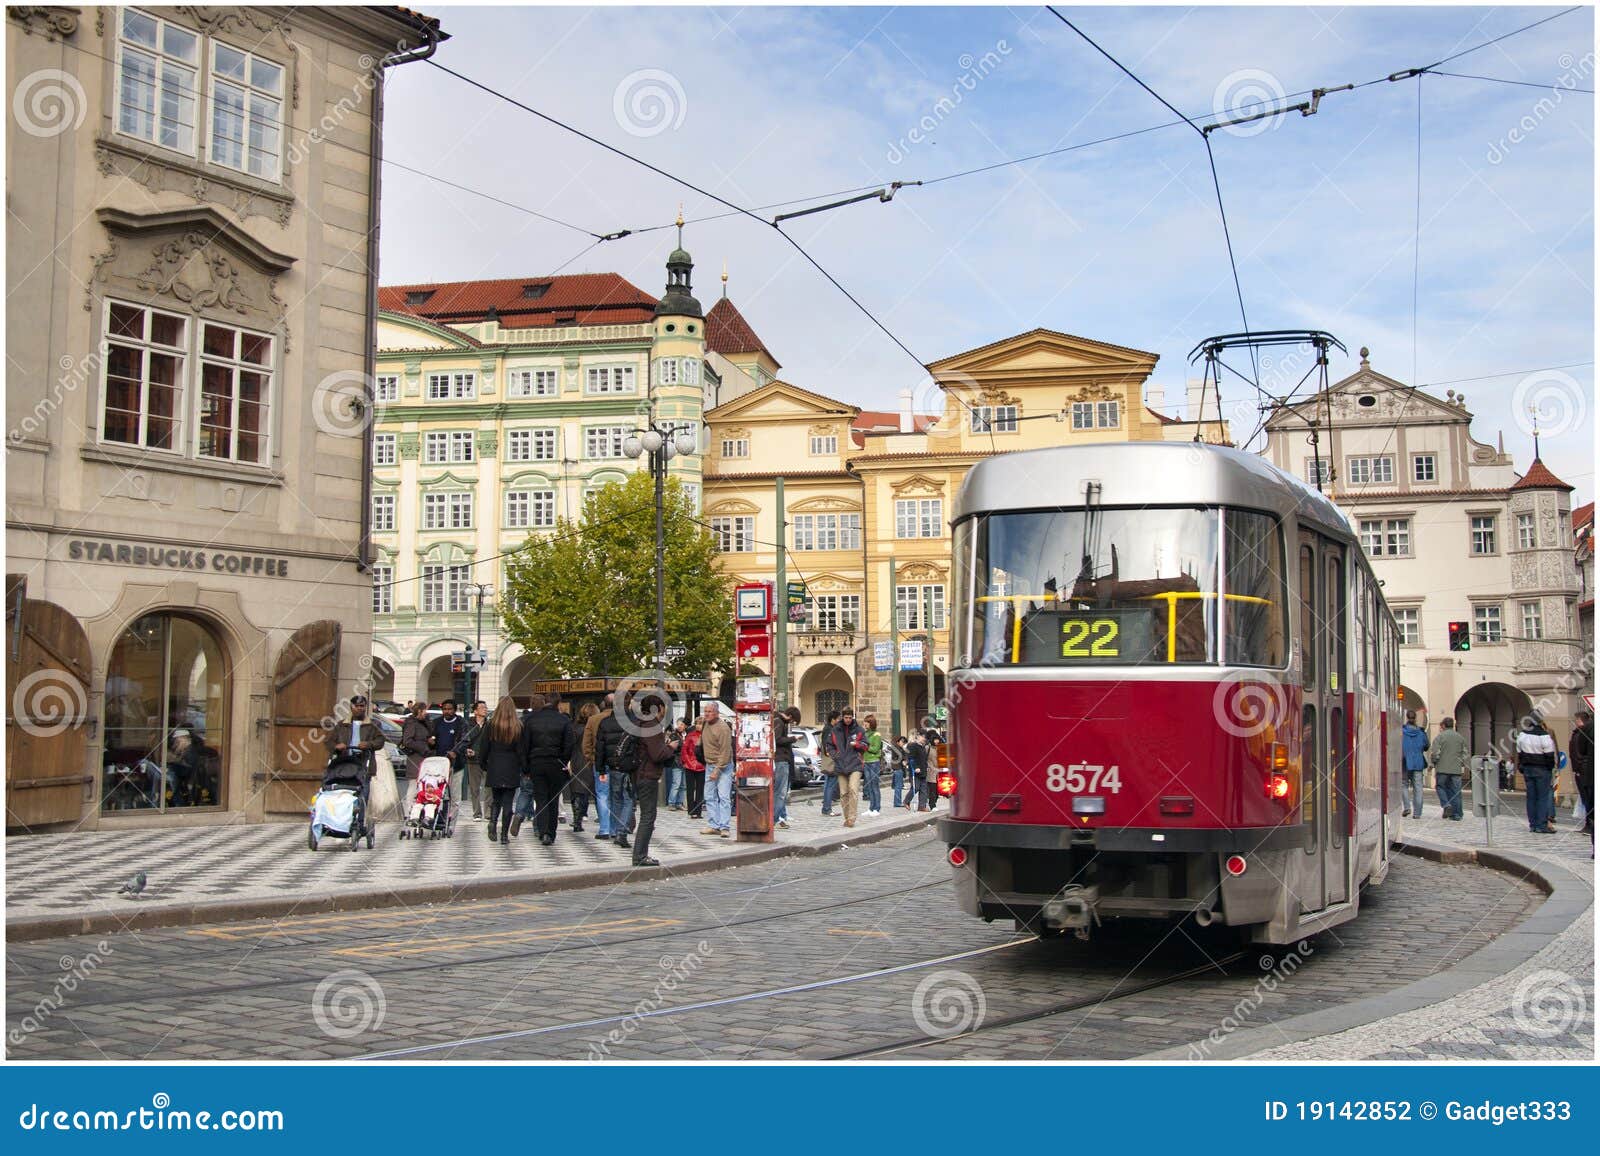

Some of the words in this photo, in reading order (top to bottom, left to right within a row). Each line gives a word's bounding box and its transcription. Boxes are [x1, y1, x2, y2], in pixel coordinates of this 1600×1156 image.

[69, 541, 206, 569] STARBUCKS
[212, 554, 289, 577] COFFEE
[1063, 619, 1119, 657] 22
[1046, 763, 1122, 794] 8574
